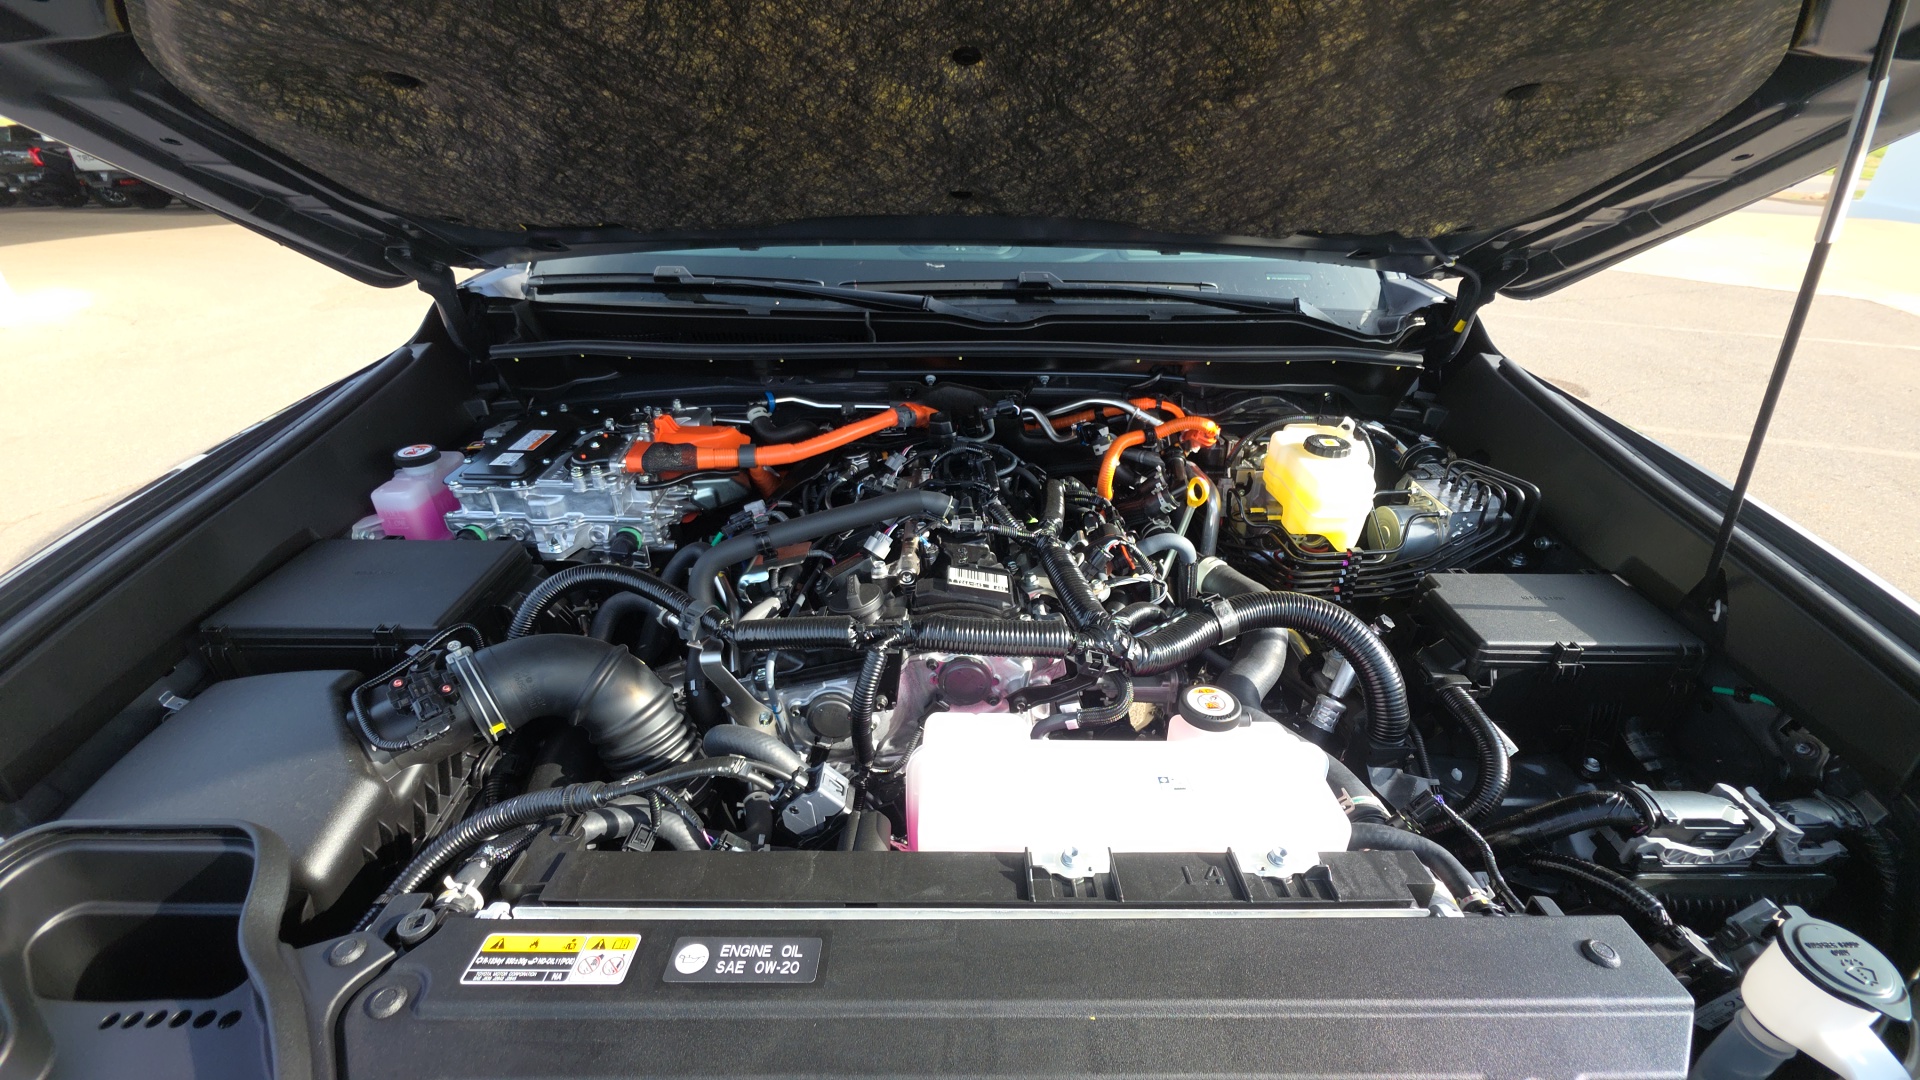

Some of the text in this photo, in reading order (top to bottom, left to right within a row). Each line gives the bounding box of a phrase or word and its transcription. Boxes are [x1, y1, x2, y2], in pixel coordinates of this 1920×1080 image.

[720, 944, 803, 958] ENGINE OIL
[715, 960, 800, 974] SAE 0W-20
[551, 972, 563, 981] NA
